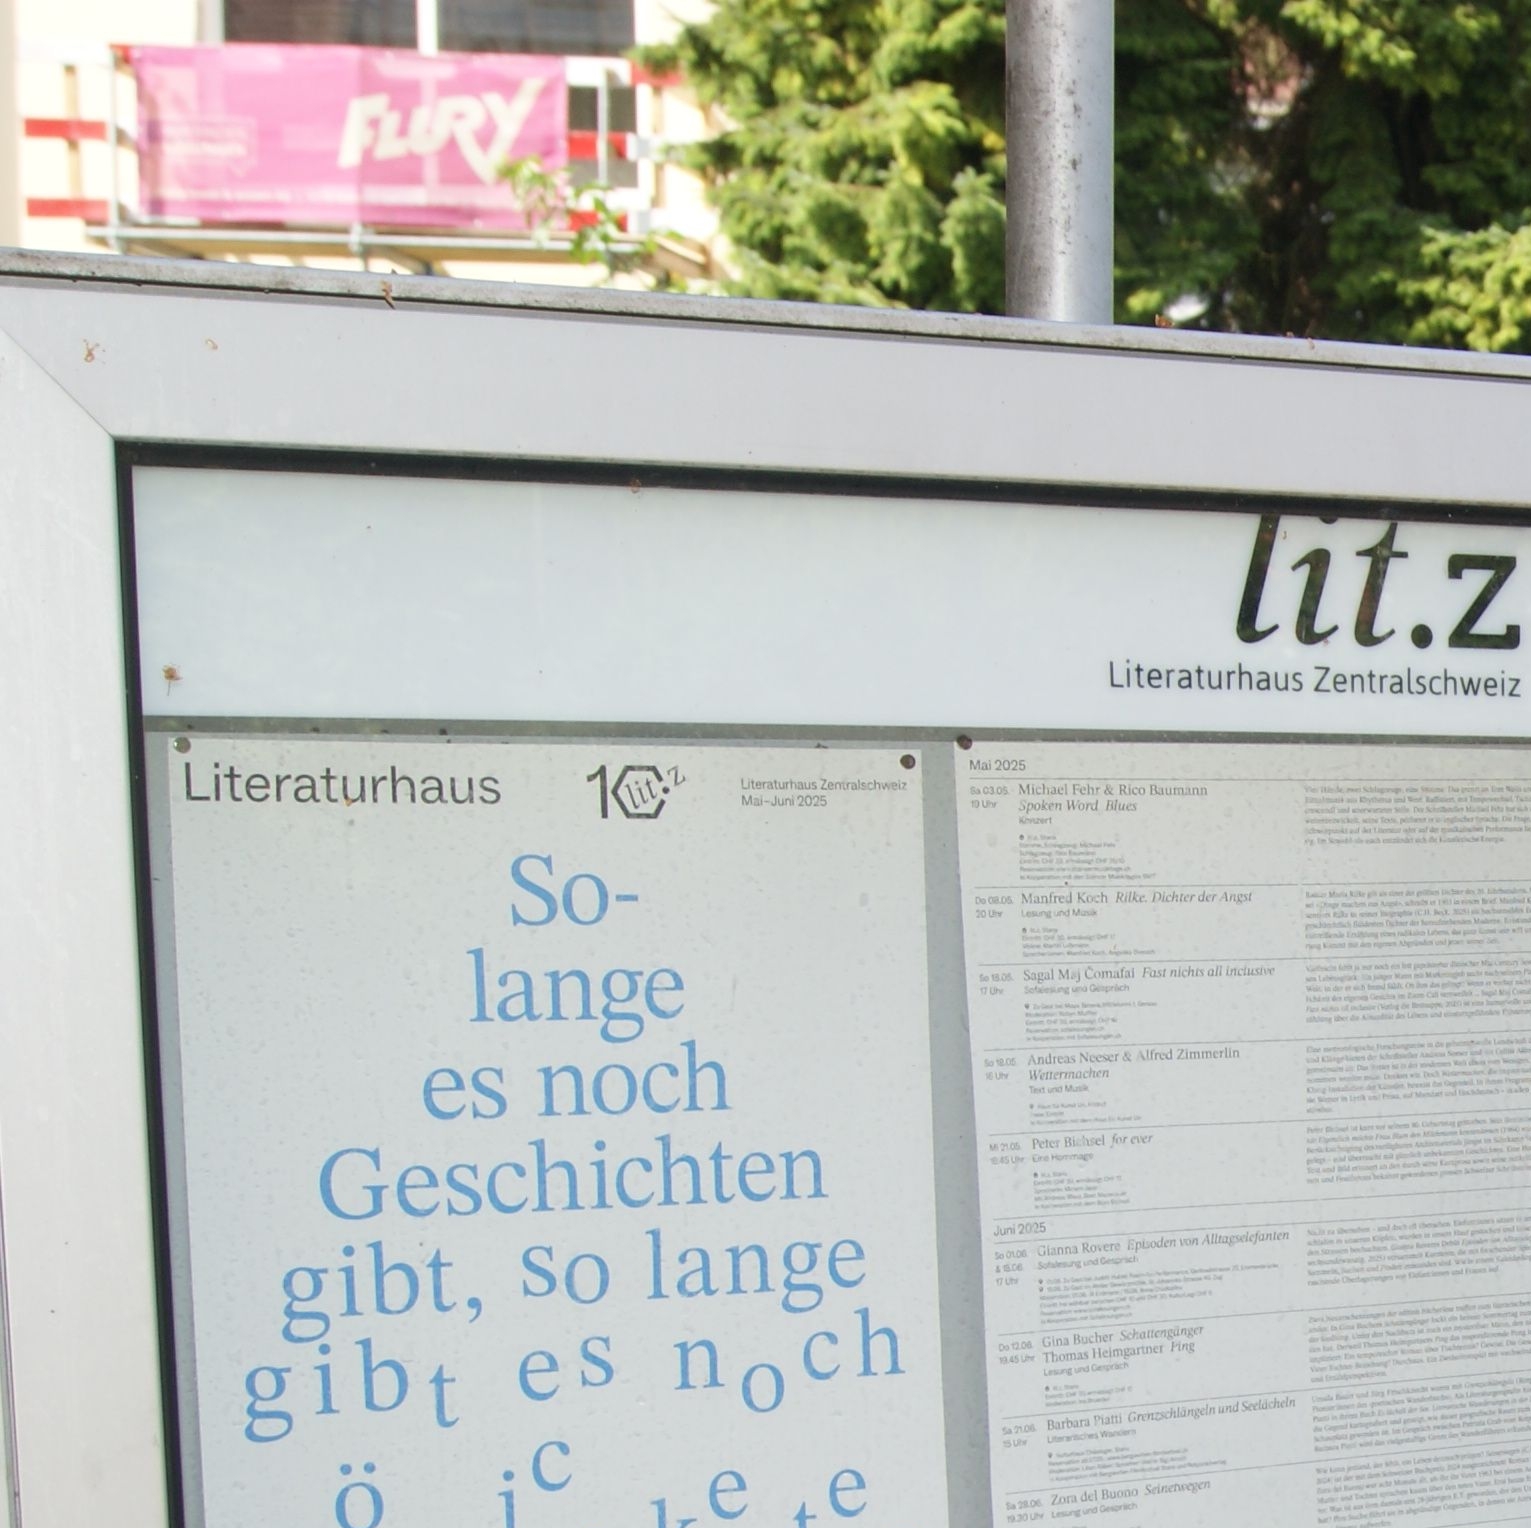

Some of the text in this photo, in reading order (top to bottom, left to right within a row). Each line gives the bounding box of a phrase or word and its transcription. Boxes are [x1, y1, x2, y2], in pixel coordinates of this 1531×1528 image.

[338, 77, 548, 186] FLURY
[1236, 513, 1521, 650] lit.z
[1110, 661, 1520, 698] Literaturhaus Zentralschweiz
[185, 762, 501, 807] Literaturhaus
[741, 777, 907, 791] Literaturhaus Zentralschweiz
[970, 759, 1026, 771] Mai 2025
[1019, 783, 1068, 795] Michael
[1073, 783, 1100, 796] Fehr
[1119, 784, 1145, 796] Rico
[1150, 784, 1207, 796] Baumann
[1018, 799, 1137, 814] Spoken Word Blues
[510, 853, 638, 926] So-
[1022, 890, 1252, 905] Manfred Koch Rilke. Dichter der Angst
[469, 948, 685, 1045] lange
[422, 1040, 730, 1121] es noch
[318, 1134, 828, 1221] Geschichten
[281, 1228, 867, 1345] gibt, so lange
[243, 1307, 906, 1444] gibt es noch
